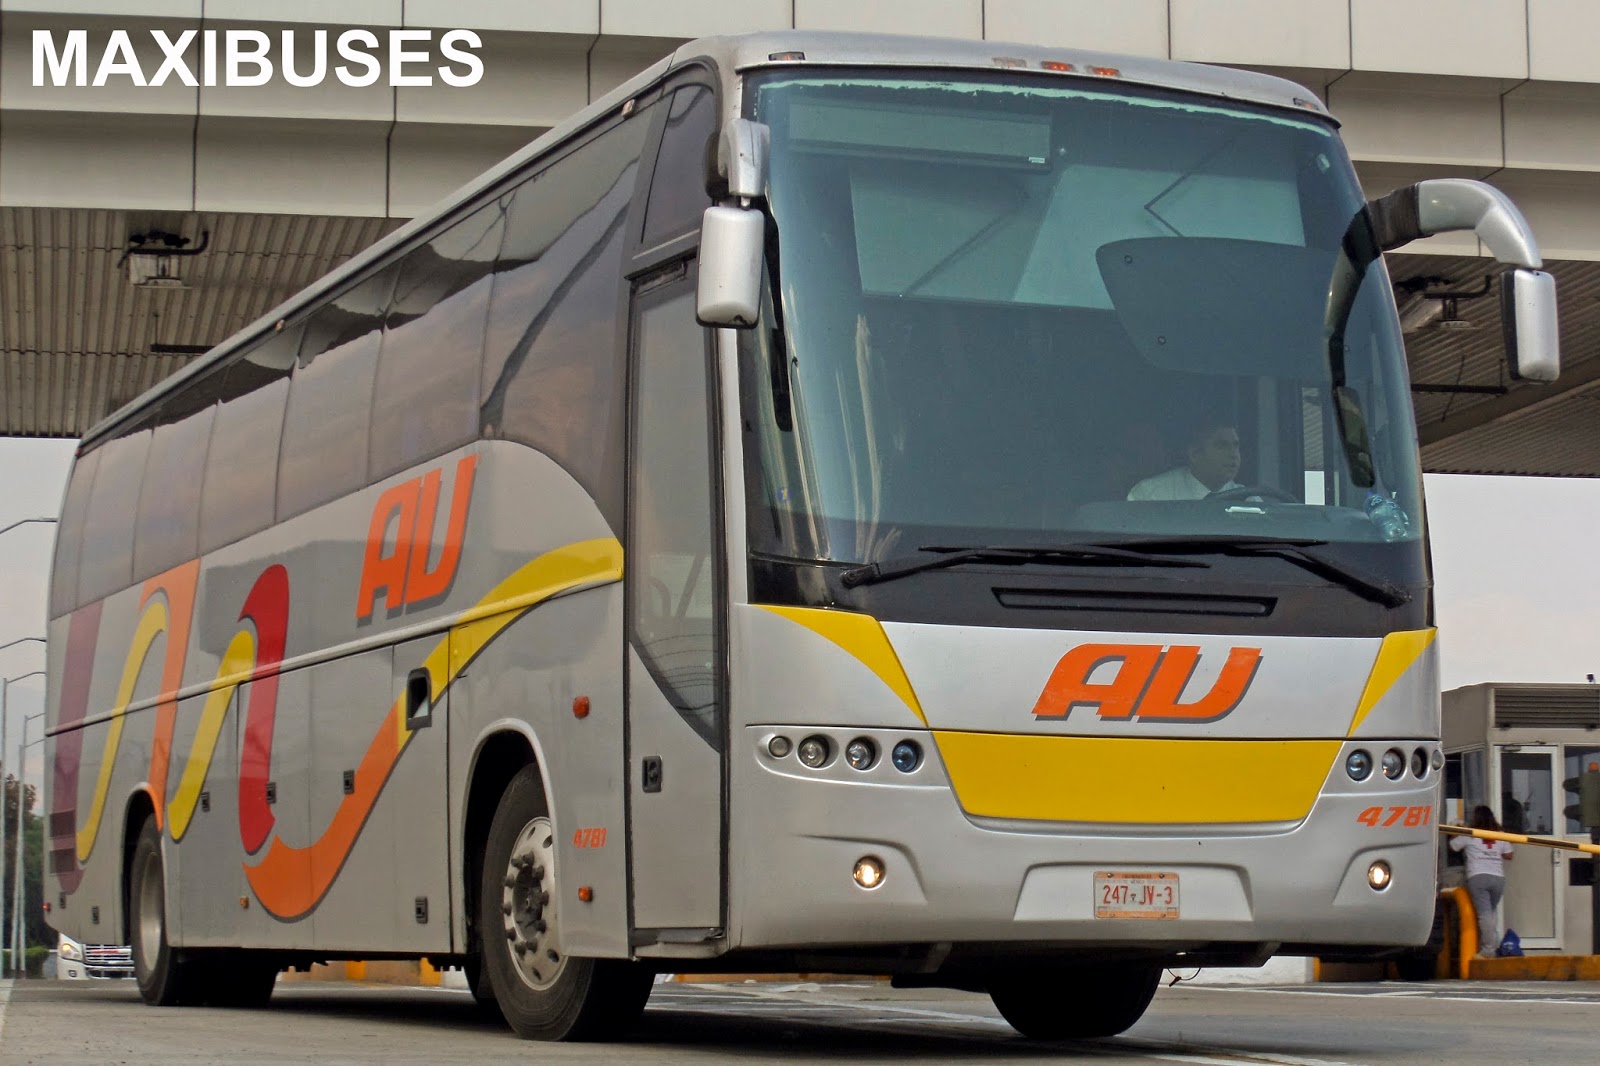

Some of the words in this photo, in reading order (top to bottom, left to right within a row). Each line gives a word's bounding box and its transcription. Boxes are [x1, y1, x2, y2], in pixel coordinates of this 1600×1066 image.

[356, 454, 476, 627] AU
[1031, 643, 1263, 723] AU
[573, 827, 607, 849] 4781
[1357, 805, 1432, 828] 4781
